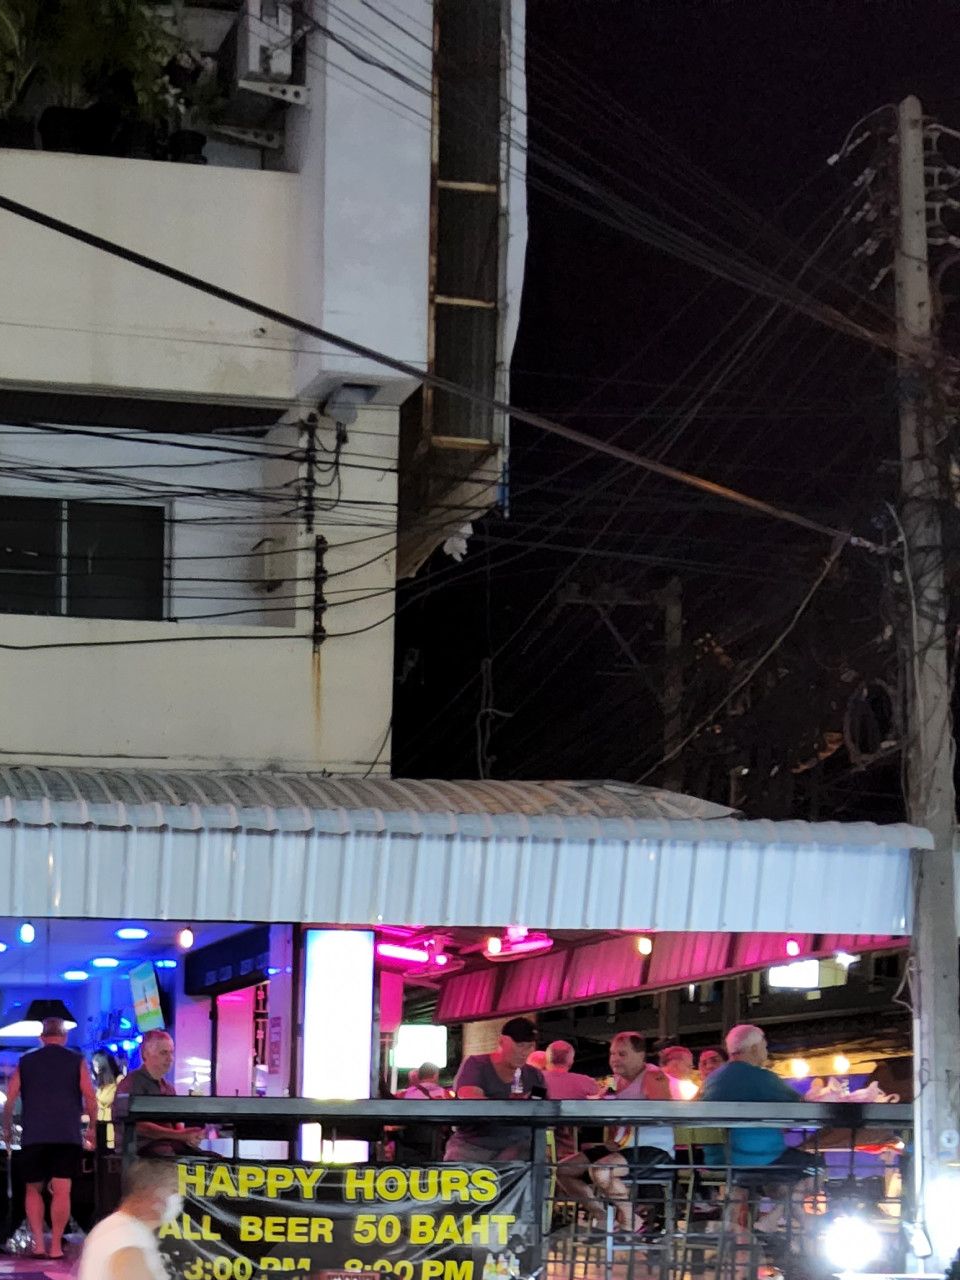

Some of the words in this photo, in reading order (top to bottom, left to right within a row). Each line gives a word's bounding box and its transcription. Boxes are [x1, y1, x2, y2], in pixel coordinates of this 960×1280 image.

[177, 1164, 326, 1199] HAPPY
[345, 1168, 498, 1202] HOURS
[158, 1213, 222, 1241] ALL
[240, 1216, 334, 1243] BEER
[352, 1214, 402, 1245] 50
[409, 1214, 516, 1245] BAHT
